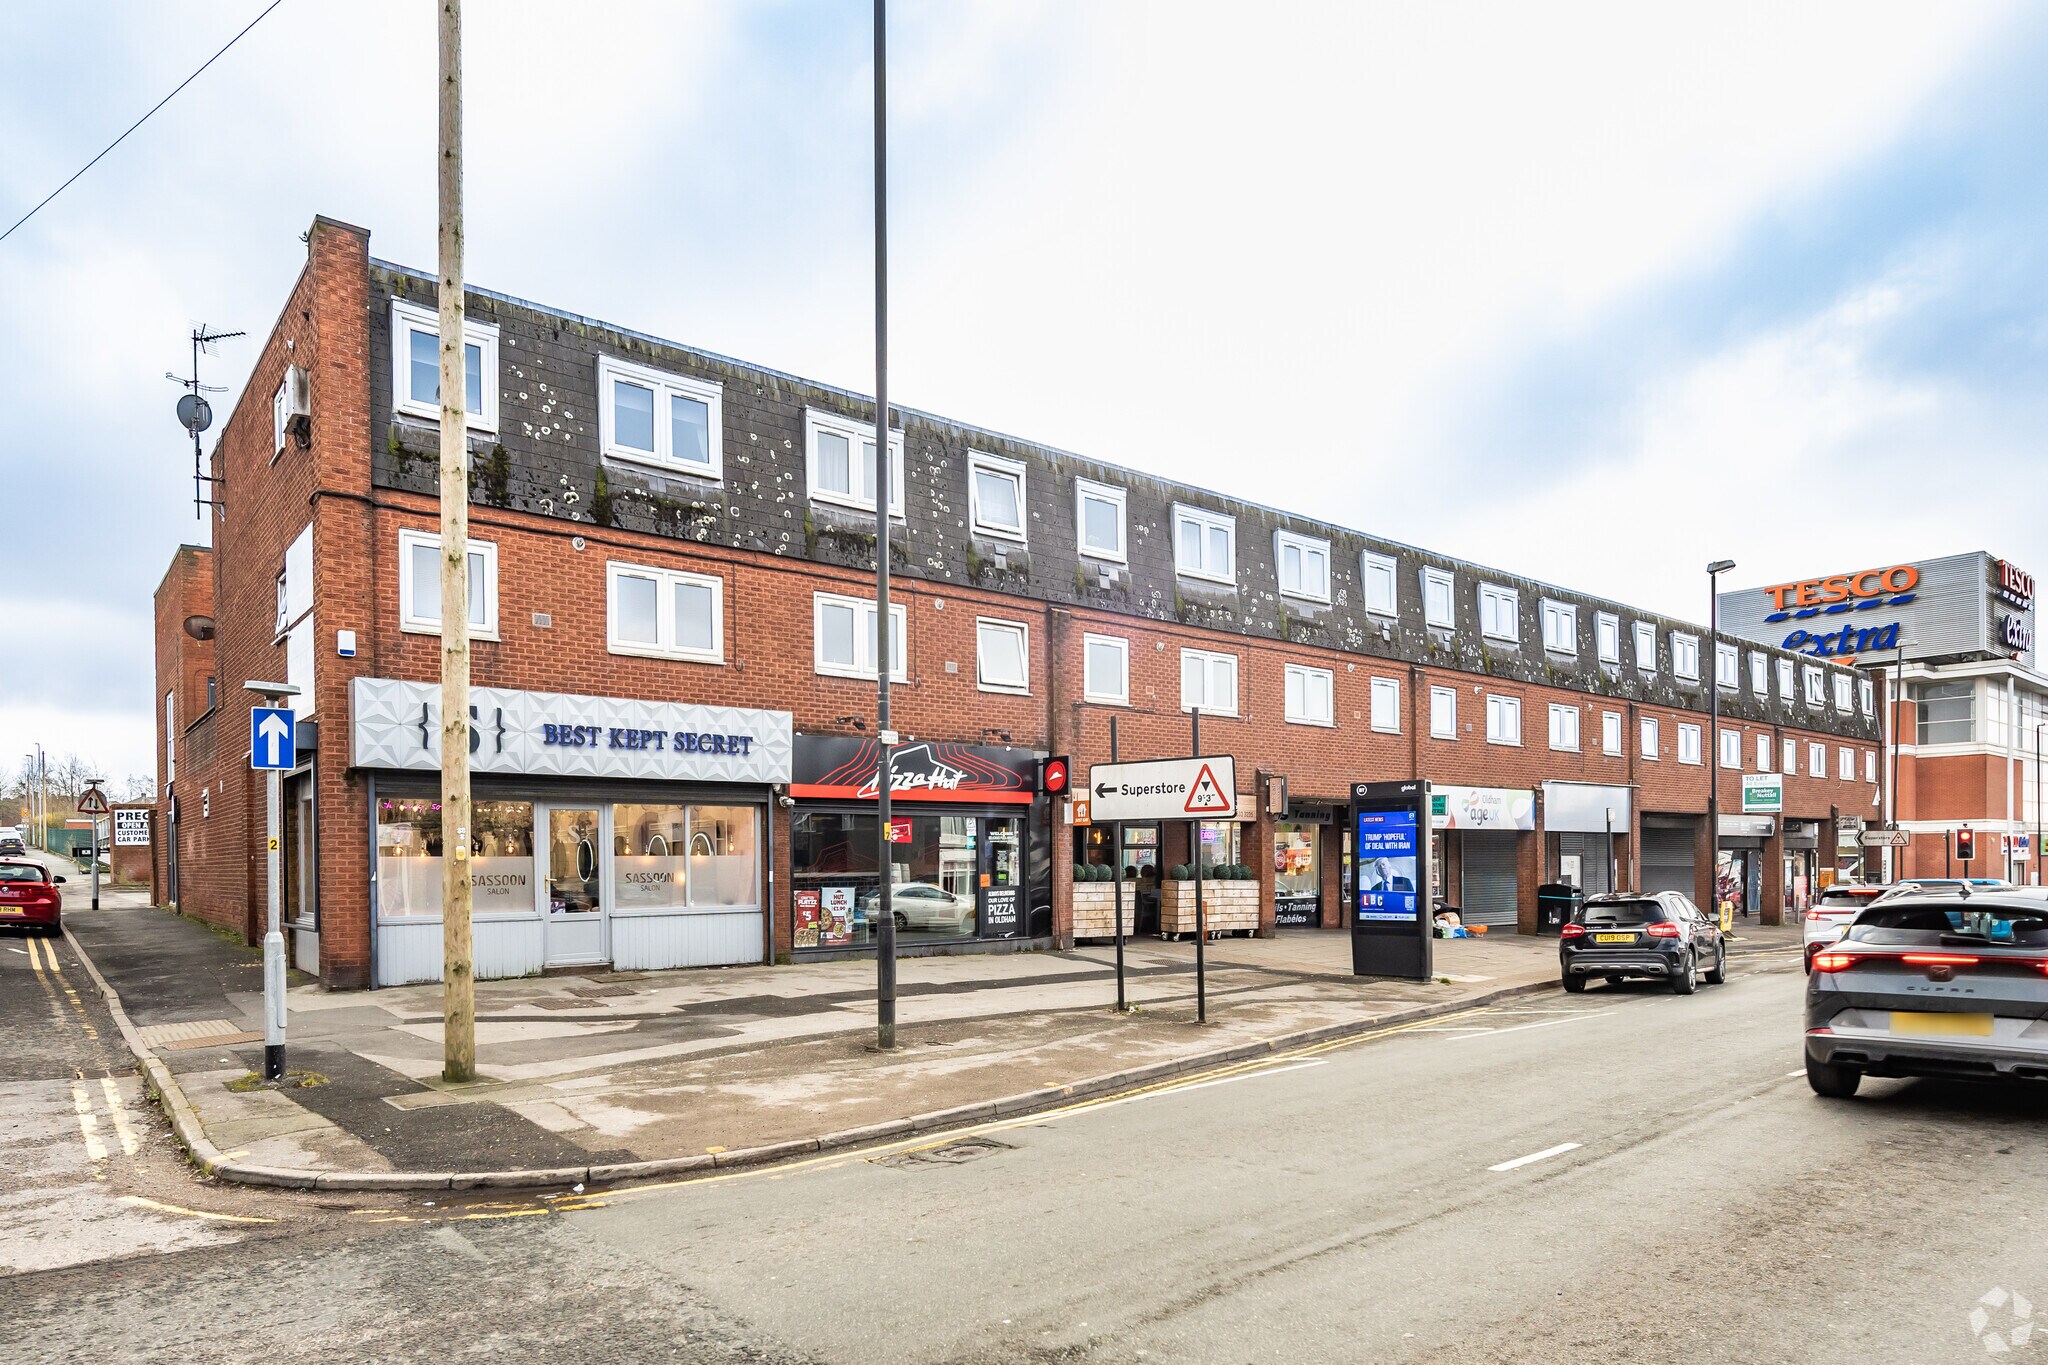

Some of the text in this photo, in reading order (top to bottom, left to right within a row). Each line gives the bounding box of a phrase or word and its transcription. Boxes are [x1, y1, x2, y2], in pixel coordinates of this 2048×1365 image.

[2000, 560, 2033, 599] TESCO
[1764, 564, 1919, 610] TESCO
[1781, 621, 1900, 656] extra
[2004, 614, 2032, 651] extra
[543, 723, 753, 755] BEST KEPT SECRET
[927, 766, 968, 790] Hut
[1121, 782, 1186, 797] Superstore
[1294, 810, 1331, 821] Tanning
[1470, 808, 1500, 826] age UK
[121, 822, 141, 830] OPEN
[270, 839, 278, 850] 2
[471, 874, 526, 886] SASSOON
[625, 872, 674, 884] SASSOON
[487, 887, 510, 895] SALON
[640, 884, 661, 892] SALON
[988, 903, 1016, 915] PIZZA
[1288, 902, 1316, 913] Tanning
[994, 916, 1016, 924] OLDHAM
